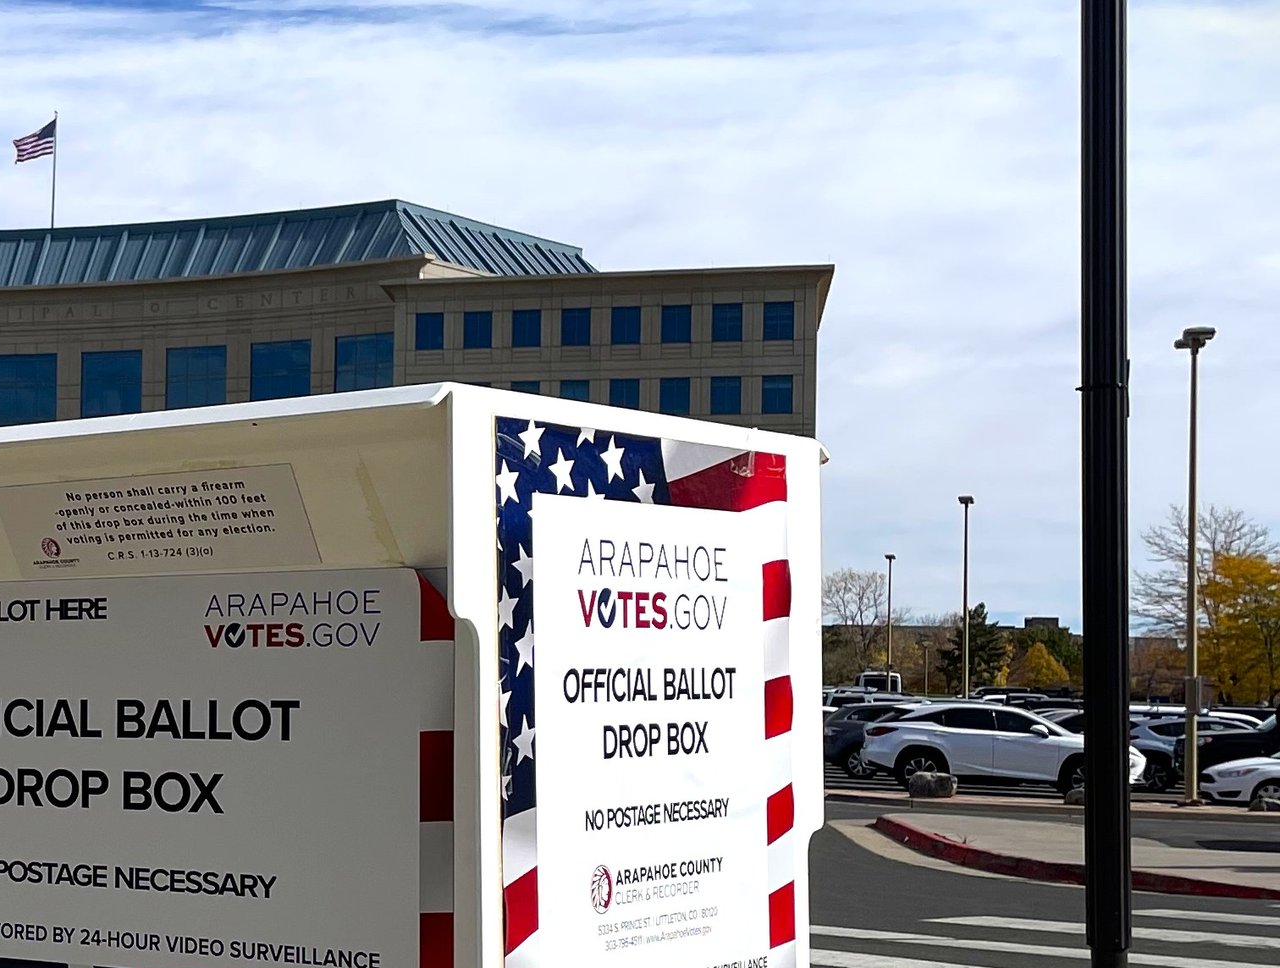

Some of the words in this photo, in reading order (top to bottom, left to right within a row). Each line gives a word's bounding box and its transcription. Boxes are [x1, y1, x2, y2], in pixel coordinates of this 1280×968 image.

[207, 286, 355, 310] CENTER
[66, 492, 81, 502] No
[85, 490, 123, 502] person
[126, 486, 154, 497] shall
[158, 485, 187, 497] carry
[191, 484, 198, 492] a
[201, 480, 245, 491] firearm
[98, 504, 110, 514] or
[215, 495, 238, 506] 100
[241, 493, 267, 504] feet
[56, 522, 67, 532] of
[70, 519, 92, 530] this
[95, 518, 121, 530] drop
[124, 516, 145, 527] box
[147, 513, 185, 526] during
[188, 512, 208, 522] the
[211, 510, 238, 521] time
[241, 508, 275, 519] when
[66, 533, 102, 546] voting
[104, 531, 115, 542] is
[118, 528, 174, 543] permitted
[177, 527, 195, 539] for
[198, 527, 219, 538] any
[222, 523, 276, 535] election.
[141, 548, 183, 558] 1-13-724
[578, 538, 728, 582] ARAPAHOE
[46, 598, 107, 620] HERE
[205, 590, 381, 618] ARAPAHOE
[577, 587, 727, 630] VOTES.GOV
[204, 622, 380, 648] VOTES.GOV
[563, 668, 657, 703] OFFICIAL
[663, 668, 736, 700] BALLOT
[117, 699, 300, 741] BALLOT
[603, 723, 661, 759] DROP
[667, 721, 709, 756] BOX
[122, 771, 224, 814] BOX
[585, 809, 604, 831] NO
[607, 803, 661, 829] POSTAGE
[663, 797, 729, 824] NECESSARY
[115, 867, 277, 898] NECESSARY
[616, 863, 677, 886] ARAPAHOE
[680, 857, 723, 877] COUNTY
[615, 889, 643, 905] CLERK
[653, 881, 699, 899] RECORDER
[53, 927, 75, 944] BY
[80, 929, 160, 952] 24-HOUR
[165, 935, 224, 957] VIDEO
